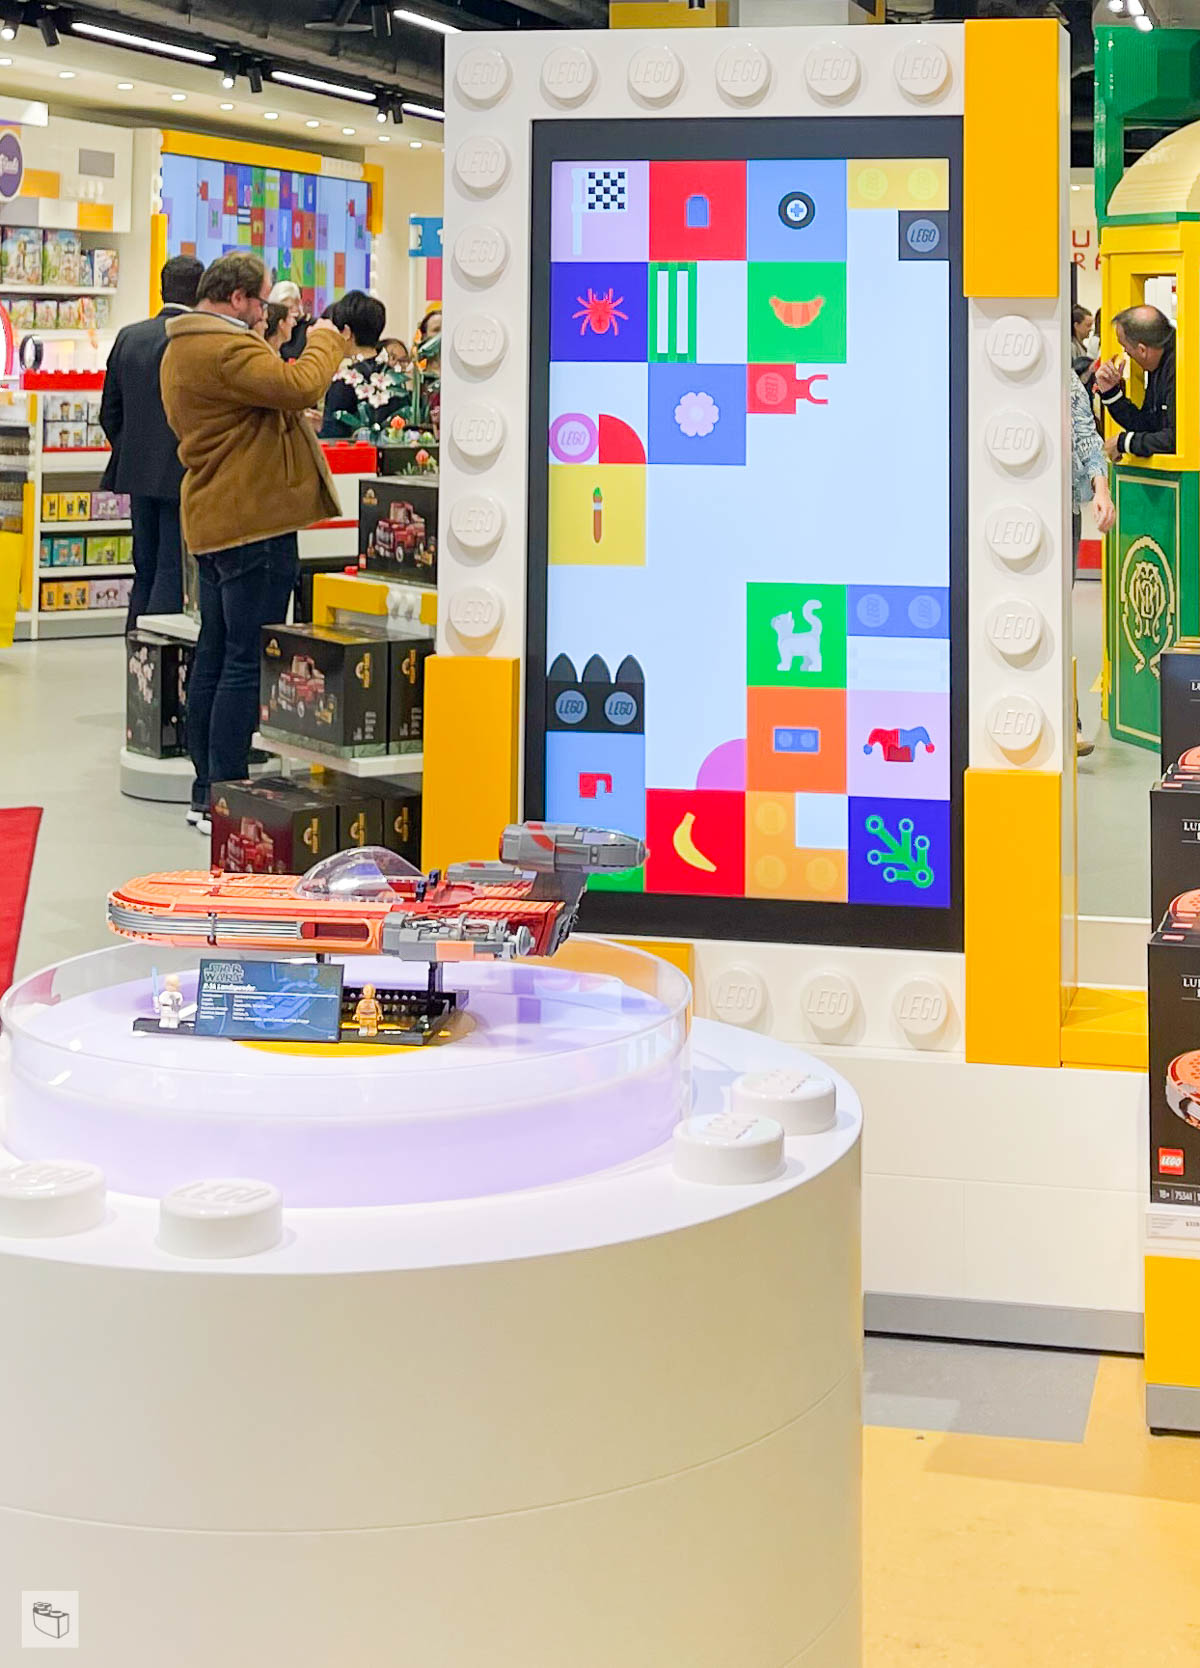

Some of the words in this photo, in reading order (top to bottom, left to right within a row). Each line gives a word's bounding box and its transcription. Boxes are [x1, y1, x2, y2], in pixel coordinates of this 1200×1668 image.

[461, 62, 499, 85] LEGO
[546, 62, 586, 84] LEGO
[633, 60, 673, 83] LEGO
[721, 59, 762, 82] LEGO
[809, 58, 851, 81] LEGO
[900, 56, 943, 79] LEGO
[457, 152, 499, 174] LEGO
[910, 228, 936, 243] LEGO
[458, 240, 498, 263] LEGO
[455, 327, 497, 351] LEGO
[991, 333, 1035, 357] LEGO
[455, 418, 496, 442] LEGO
[561, 431, 586, 445] LEGO
[991, 426, 1035, 450] LEGO
[455, 507, 495, 533] LEGO
[992, 521, 1035, 545] LEGO
[453, 601, 494, 625] LEGO
[992, 616, 1035, 640] LEGO
[560, 700, 584, 714] LEGO
[608, 701, 633, 715] LEGO
[992, 711, 1036, 736] LEGO
[204, 972, 244, 983] WARS
[210, 963, 243, 973] STAR
[715, 985, 757, 1010] LEGO
[807, 990, 848, 1016] LEGO
[898, 995, 942, 1021] LEGO
[1160, 1156, 1183, 1166] LEGO
[169, 1181, 272, 1204] LEGO
